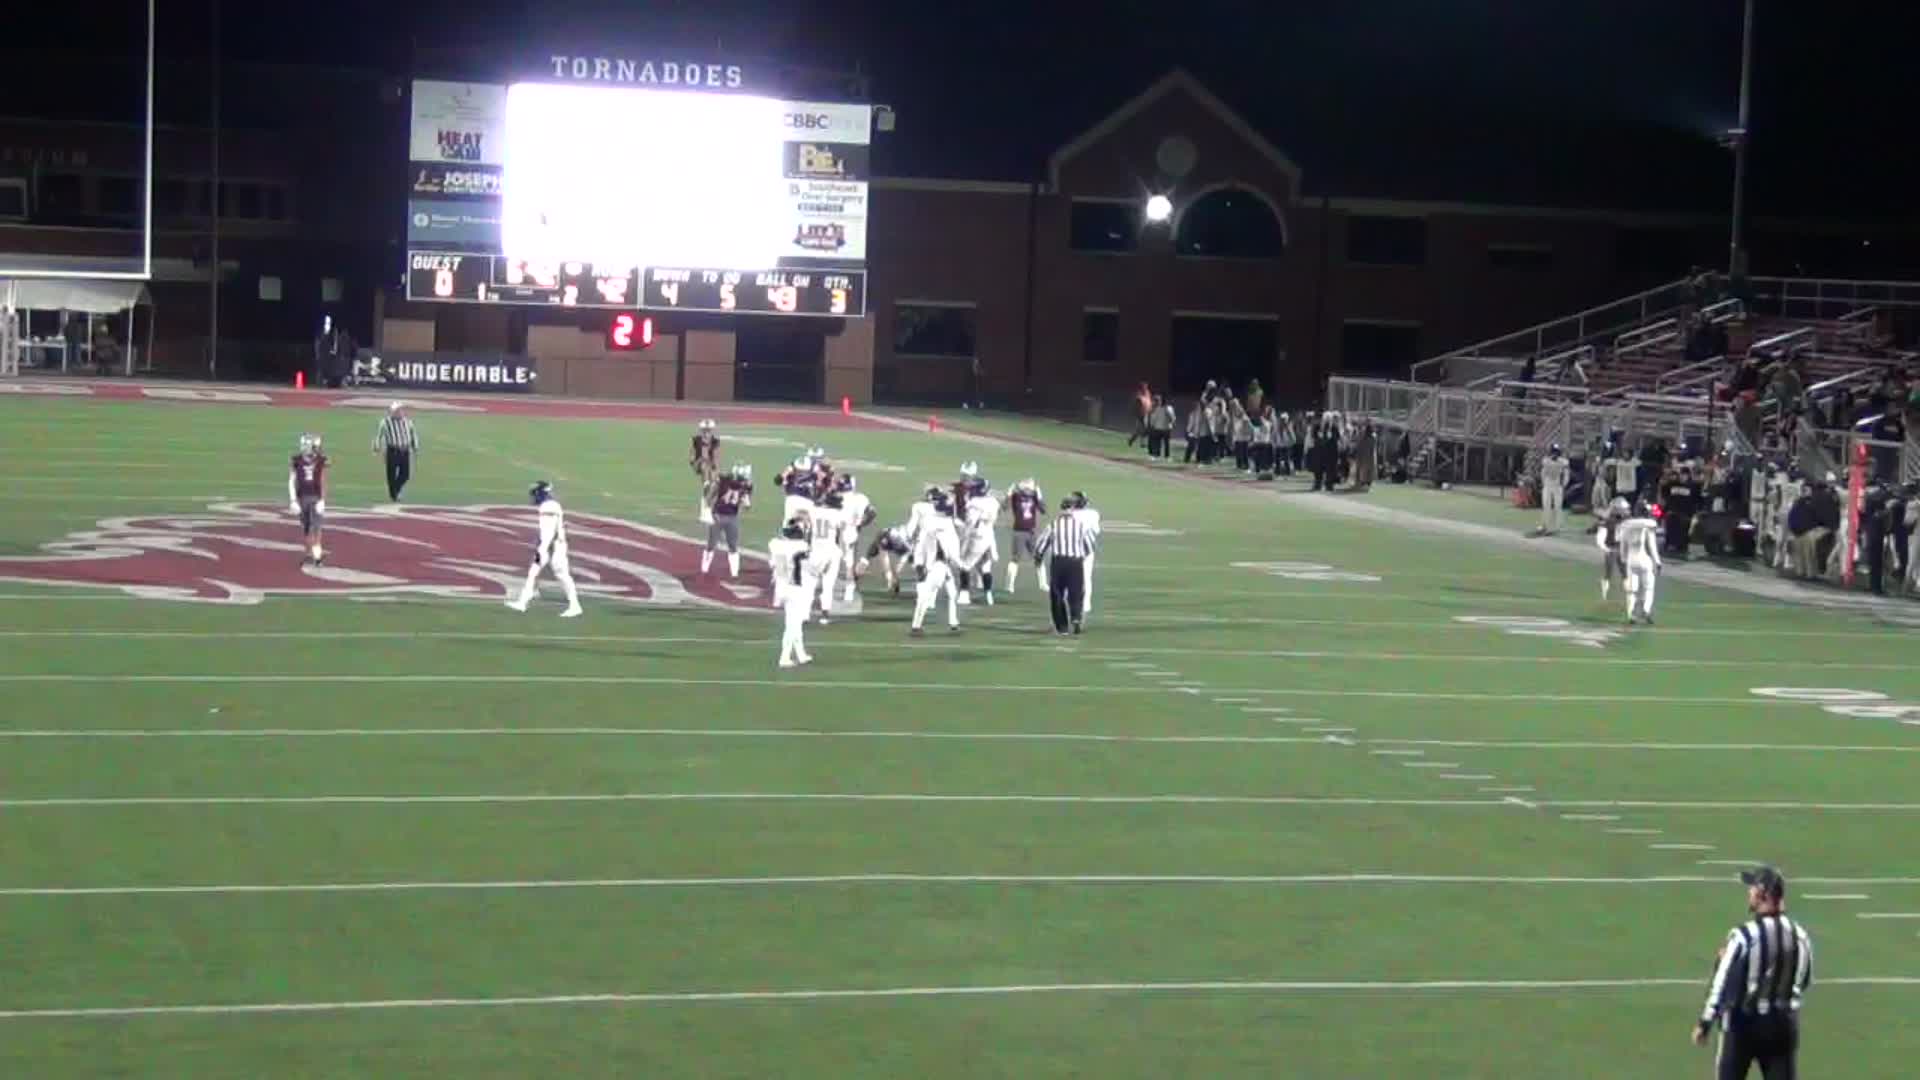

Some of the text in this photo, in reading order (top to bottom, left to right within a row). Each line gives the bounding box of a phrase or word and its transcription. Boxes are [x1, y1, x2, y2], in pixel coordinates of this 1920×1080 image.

[551, 55, 742, 88] TORNADOES
[412, 255, 462, 271] GUEST
[435, 271, 454, 296] 0
[791, 274, 810, 287] ON
[661, 282, 679, 306] 4
[719, 284, 736, 309] 5
[830, 289, 846, 314] 3
[613, 315, 652, 346] 21
[398, 362, 528, 384] UNDENIABLE
